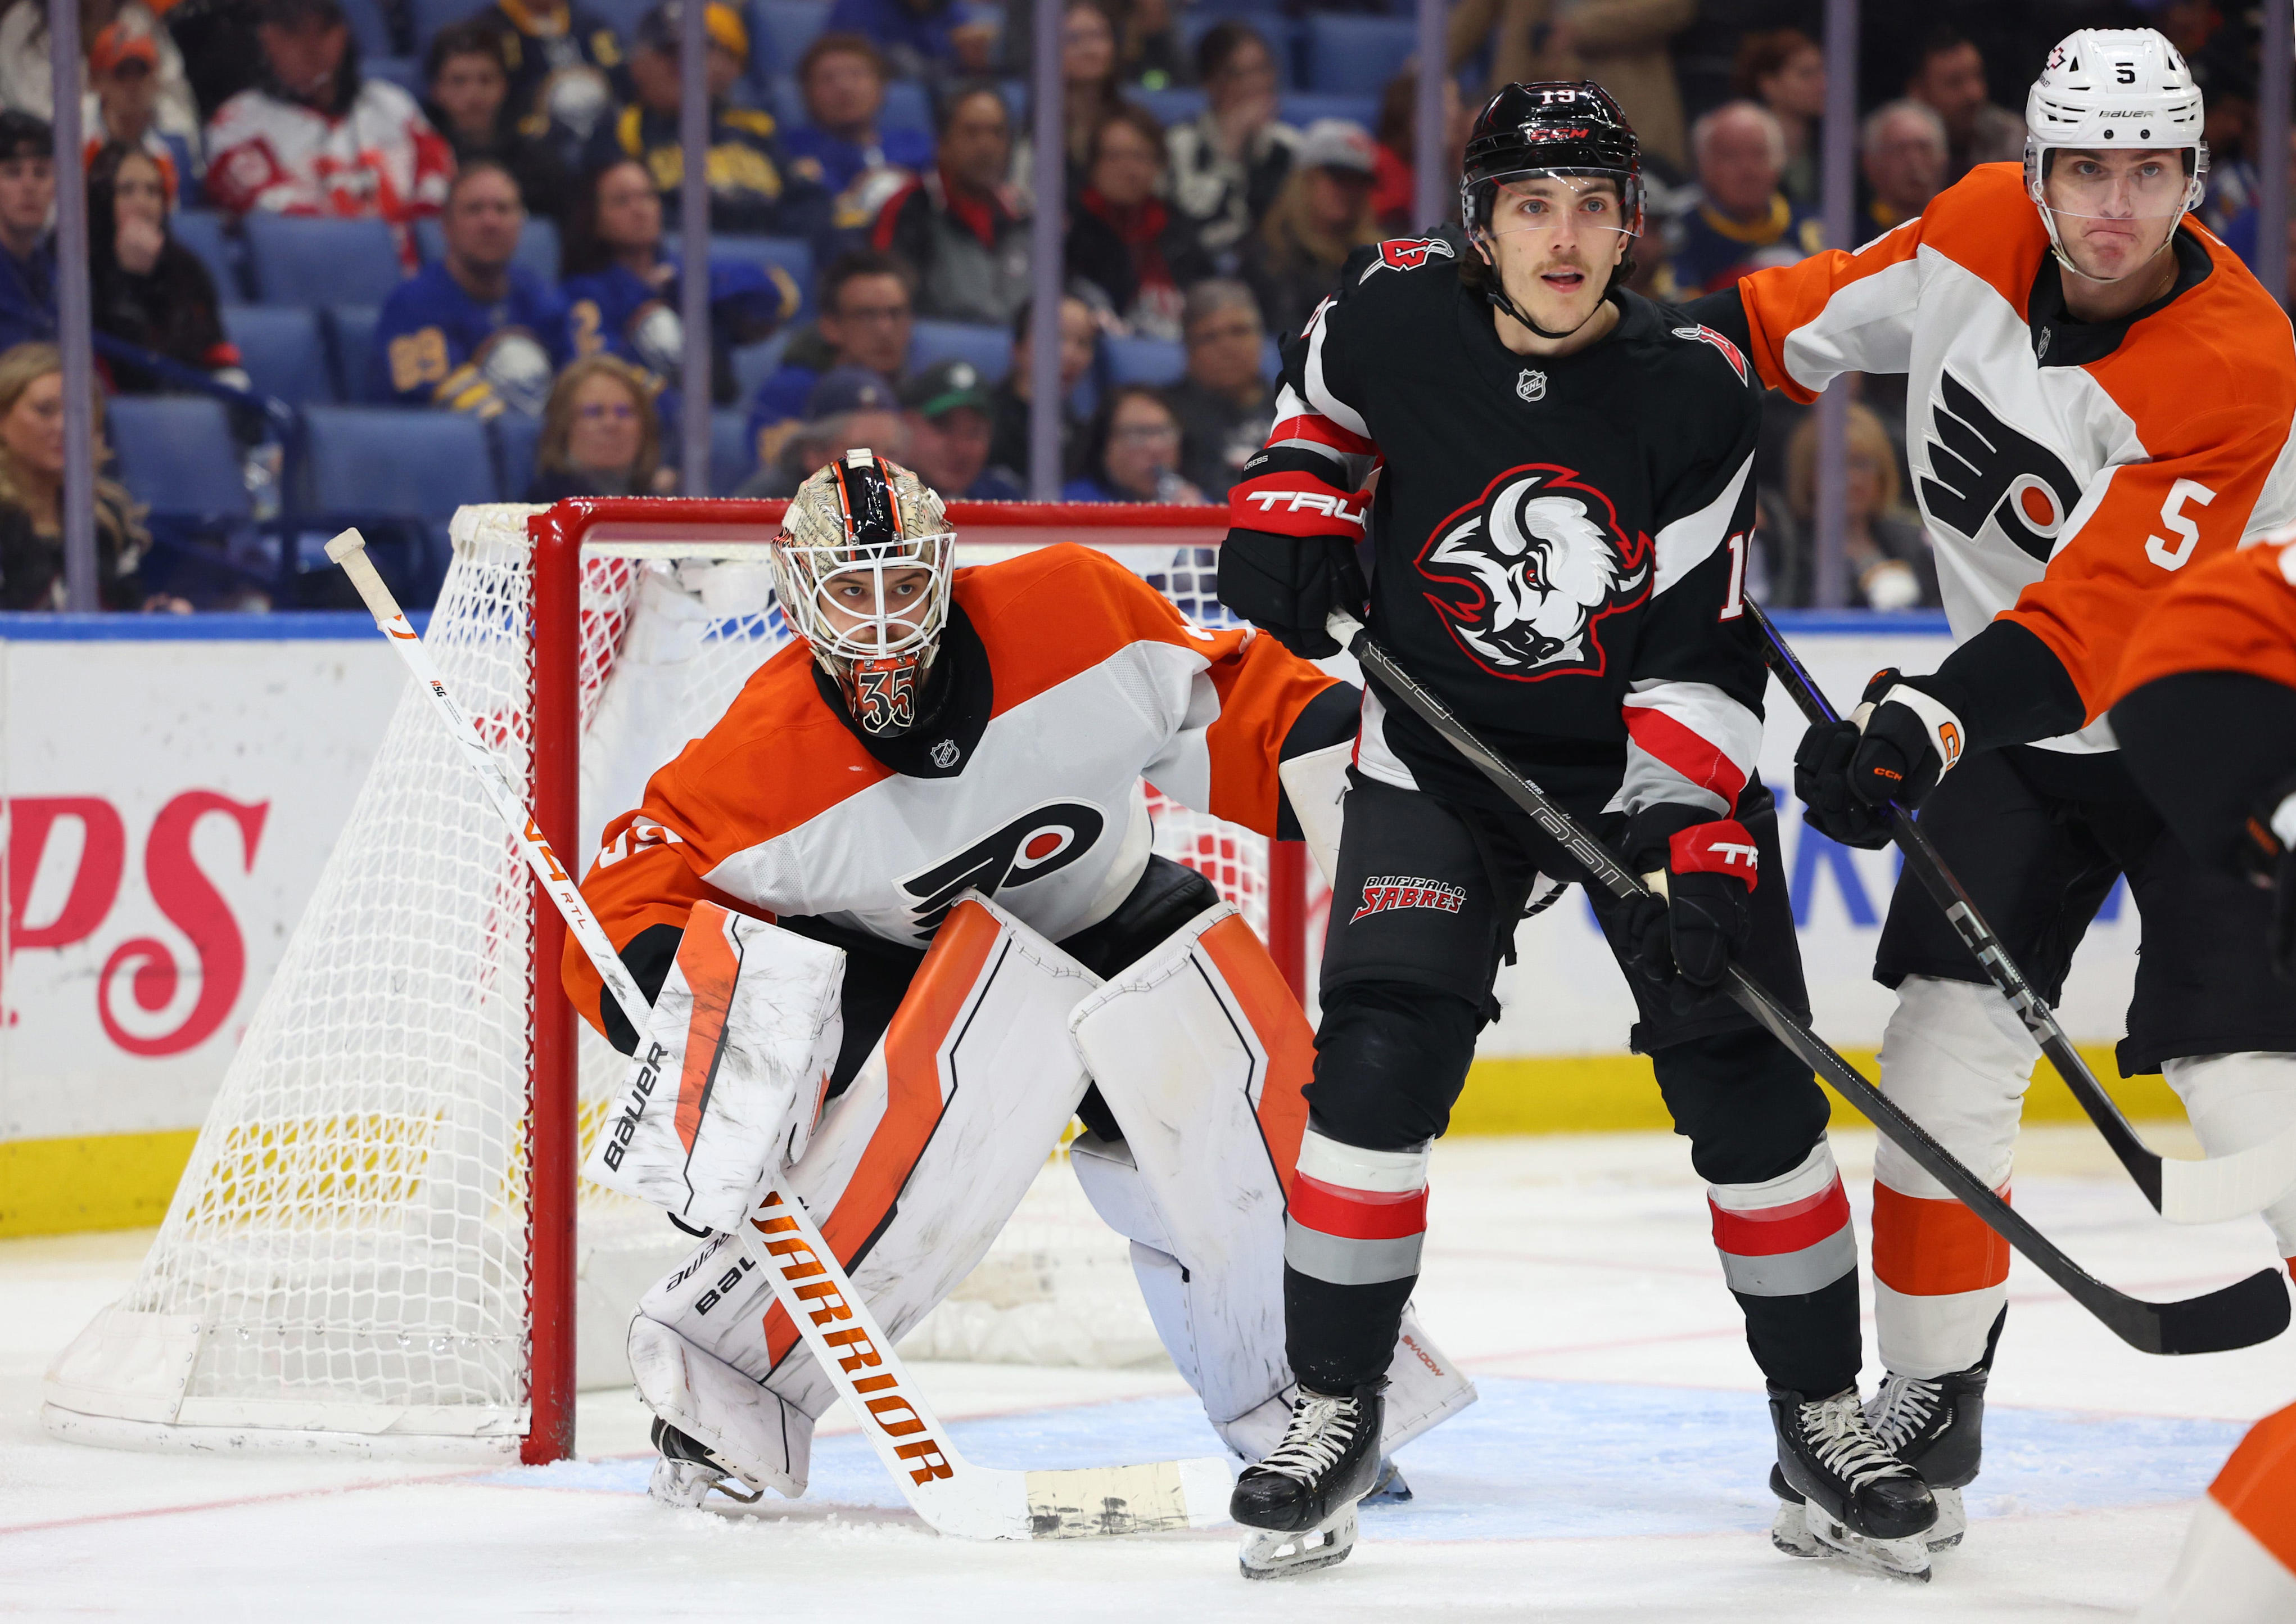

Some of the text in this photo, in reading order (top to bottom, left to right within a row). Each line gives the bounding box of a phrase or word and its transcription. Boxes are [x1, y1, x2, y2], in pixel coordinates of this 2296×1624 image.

[2116, 62, 2136, 84] 5
[1542, 89, 1576, 106] 19
[1523, 379, 1542, 394] NHL
[1244, 455, 1268, 472] KREBS
[1246, 491, 1367, 532] TRU
[2145, 477, 2217, 572] 5
[1718, 524, 1756, 622] 1
[858, 666, 915, 733] 35
[1525, 779, 1544, 795] KREBS
[1873, 767, 1904, 782] CCM
[1363, 876, 1466, 898] BUFFALO
[561, 892, 587, 930] RTL
[1349, 886, 1467, 926] SABRES
[1402, 1334, 1445, 1378] SHADOW
